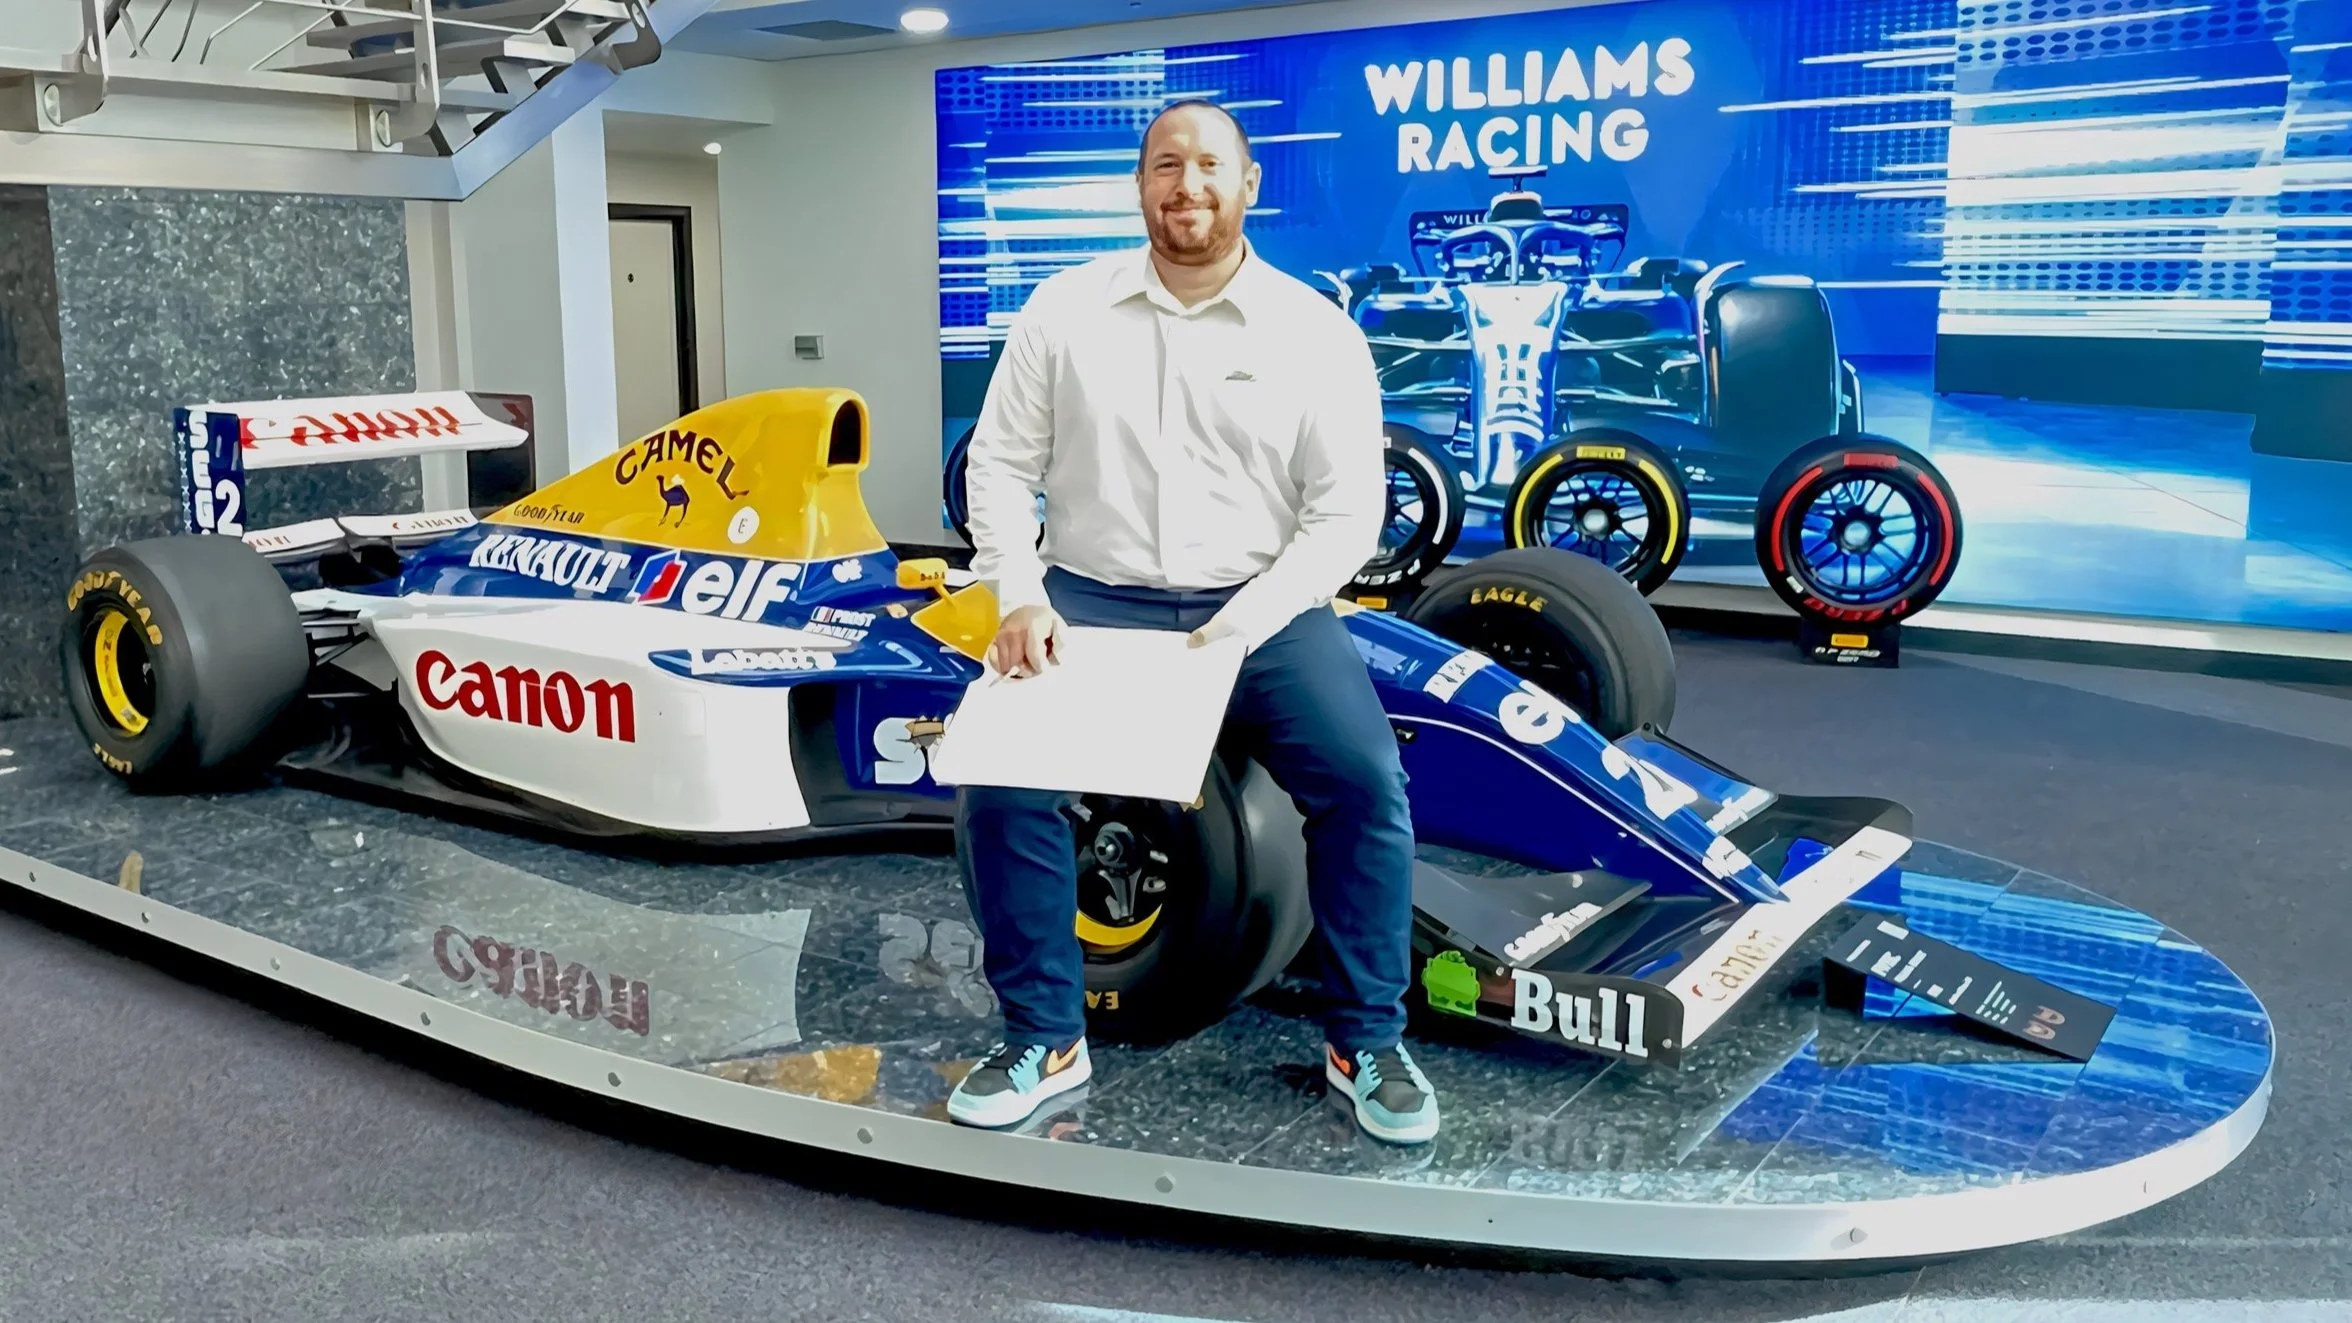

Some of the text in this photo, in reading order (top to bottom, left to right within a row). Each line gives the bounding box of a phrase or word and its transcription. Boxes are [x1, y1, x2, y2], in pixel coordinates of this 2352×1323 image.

[1364, 37, 1696, 116] WILLIAMS
[1397, 108, 1650, 173] RACING
[188, 409, 215, 536] SEG
[614, 429, 750, 500] CAMEL
[215, 480, 243, 537] 2
[469, 533, 632, 595] RENAULT
[681, 559, 802, 623] elf
[1470, 586, 1549, 613] EAGLE
[416, 650, 636, 743] Canon
[1511, 968, 1649, 1058] Bull
